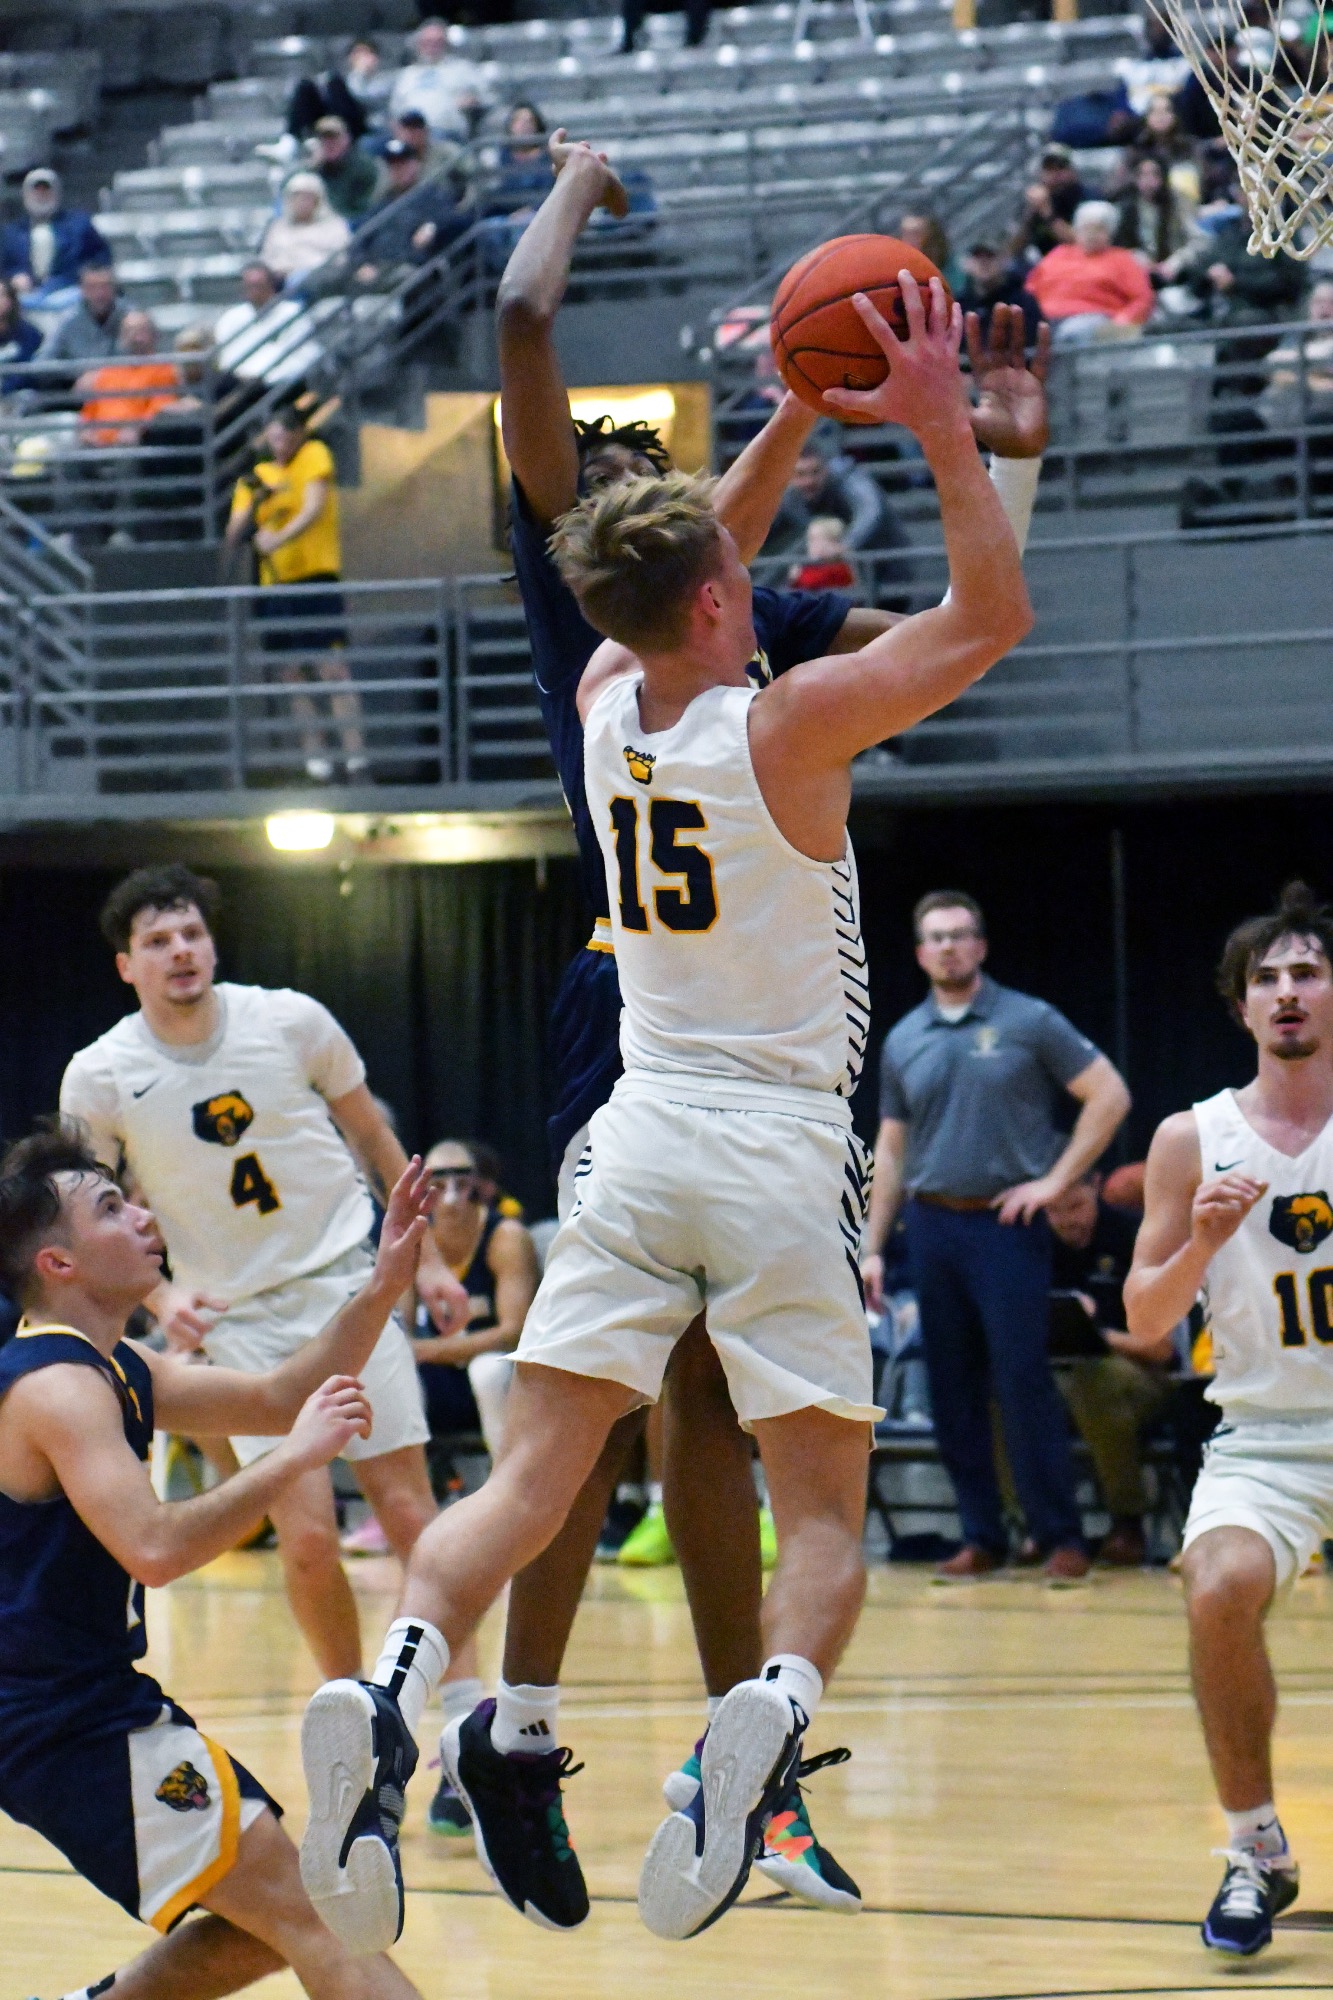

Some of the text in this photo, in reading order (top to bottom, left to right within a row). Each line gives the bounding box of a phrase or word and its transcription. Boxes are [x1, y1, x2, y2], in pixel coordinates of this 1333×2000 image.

[608, 794, 720, 934] 15
[229, 1150, 283, 1217] 4
[1272, 1266, 1333, 1348] 10
